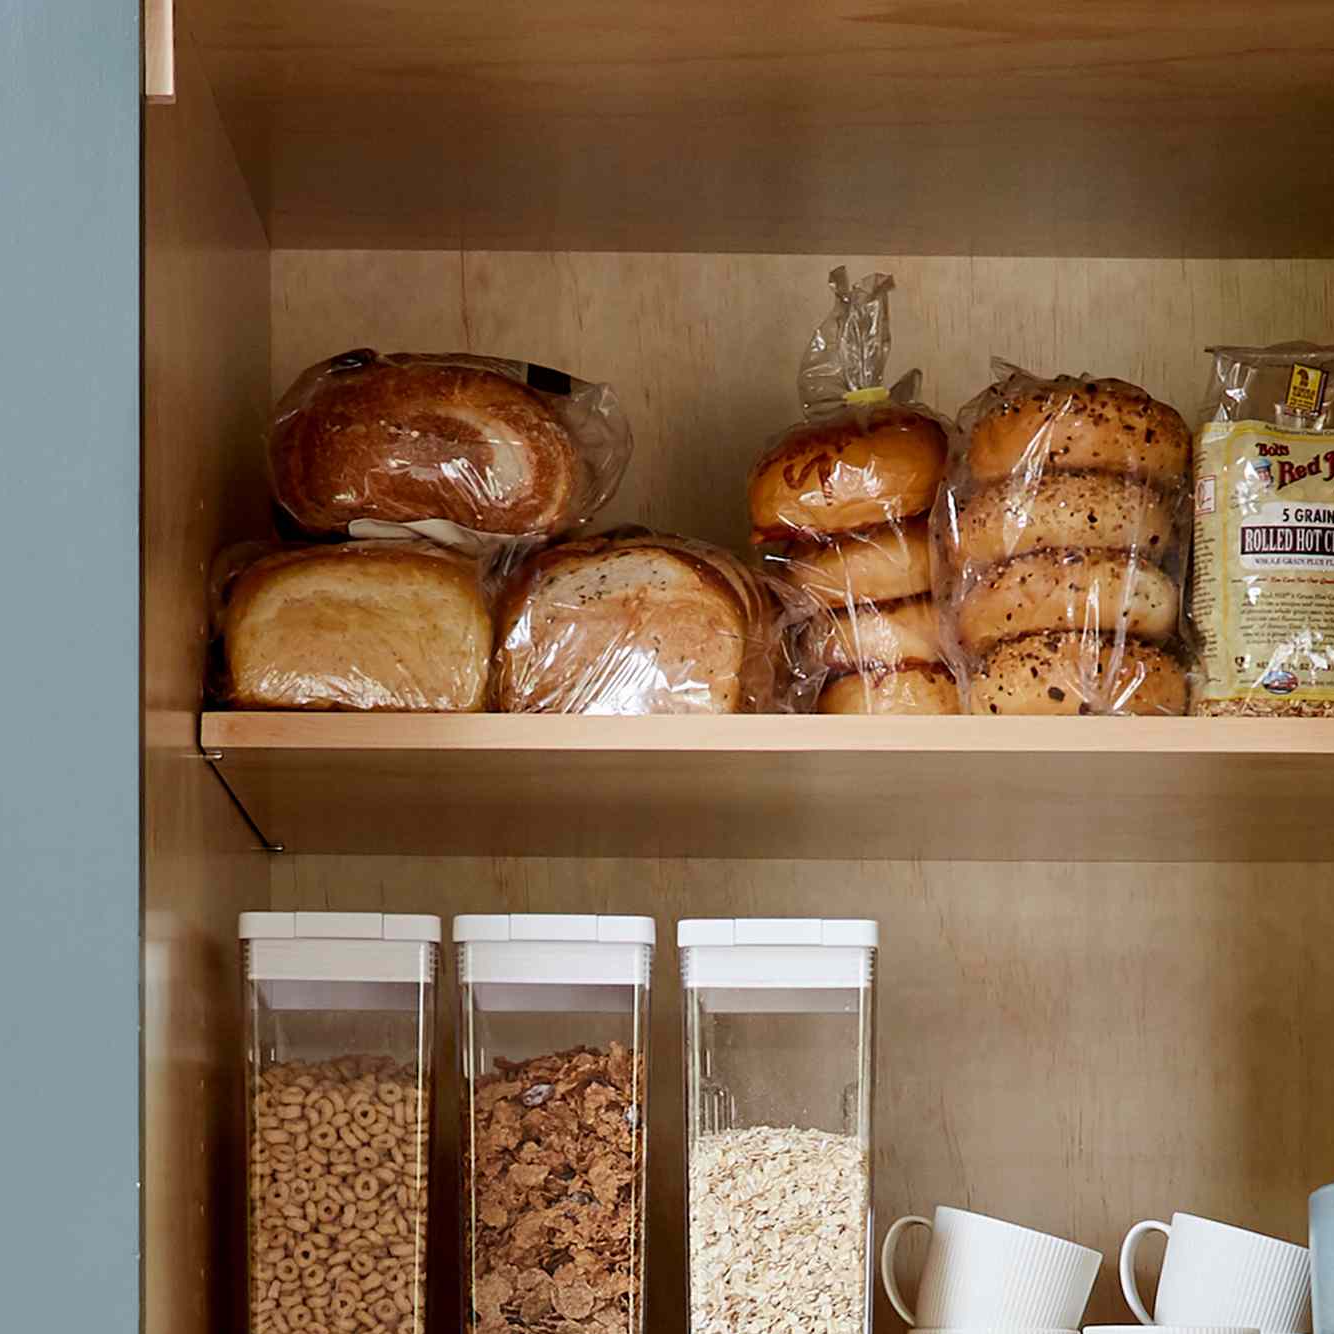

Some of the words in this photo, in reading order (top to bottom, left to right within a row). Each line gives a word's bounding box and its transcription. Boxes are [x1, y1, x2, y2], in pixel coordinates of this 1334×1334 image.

[1276, 453, 1322, 491] Red
[1281, 507, 1290, 522] 5
[1244, 528, 1294, 553] ROLLED
[1296, 529, 1323, 553] HOT
